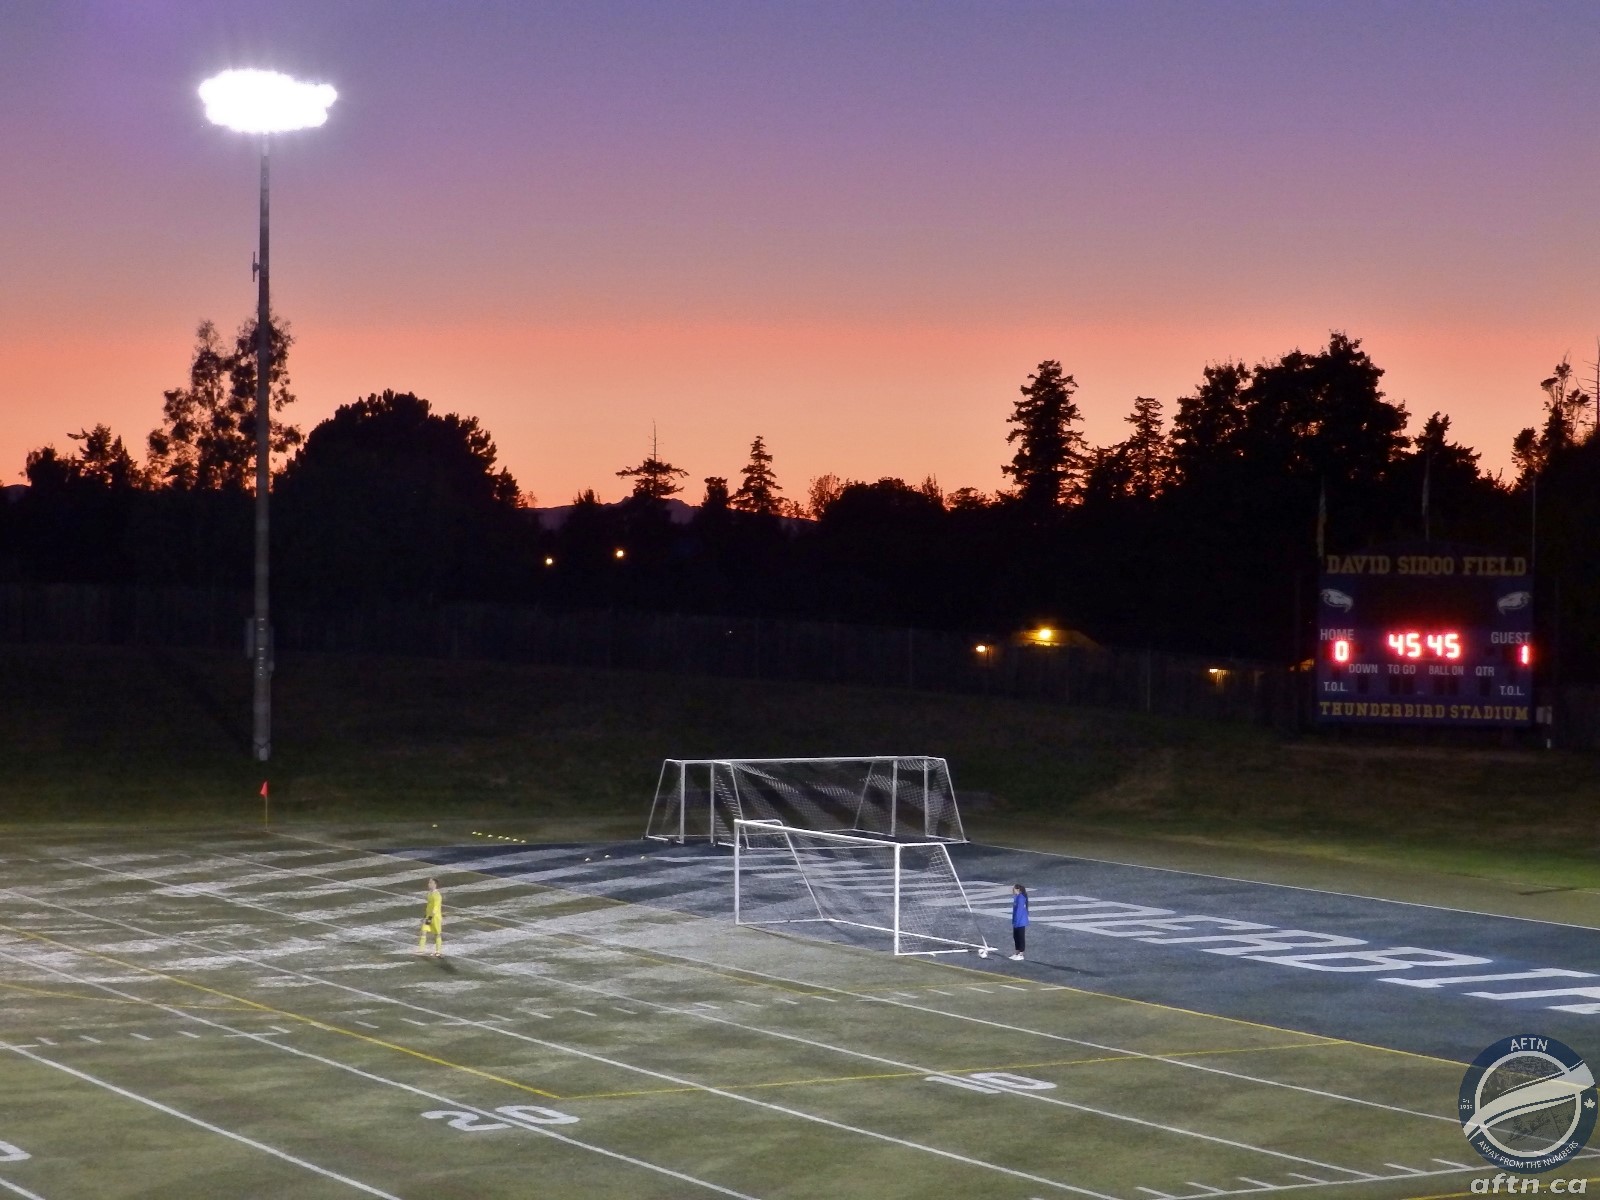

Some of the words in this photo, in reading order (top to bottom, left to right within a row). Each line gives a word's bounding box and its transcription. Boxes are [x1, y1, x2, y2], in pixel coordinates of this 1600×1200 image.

[1326, 555, 1390, 575] DAVID
[1397, 556, 1454, 576] SIDOO
[1463, 556, 1527, 576] FIELD
[1320, 629, 1354, 641] HOME
[1491, 632, 1530, 644] GUEST
[1334, 640, 1350, 662] 0
[1521, 644, 1529, 665] 1
[1348, 663, 1378, 674] DOWN
[1387, 664, 1400, 674] TO
[1402, 664, 1416, 675] GO
[1428, 665, 1449, 675] BALL
[1451, 665, 1464, 676] ON
[1475, 666, 1495, 676] QTR
[1319, 701, 1446, 719] THUNDERBIRD
[1450, 704, 1529, 721] STADIUM
[420, 1105, 581, 1131] 20
